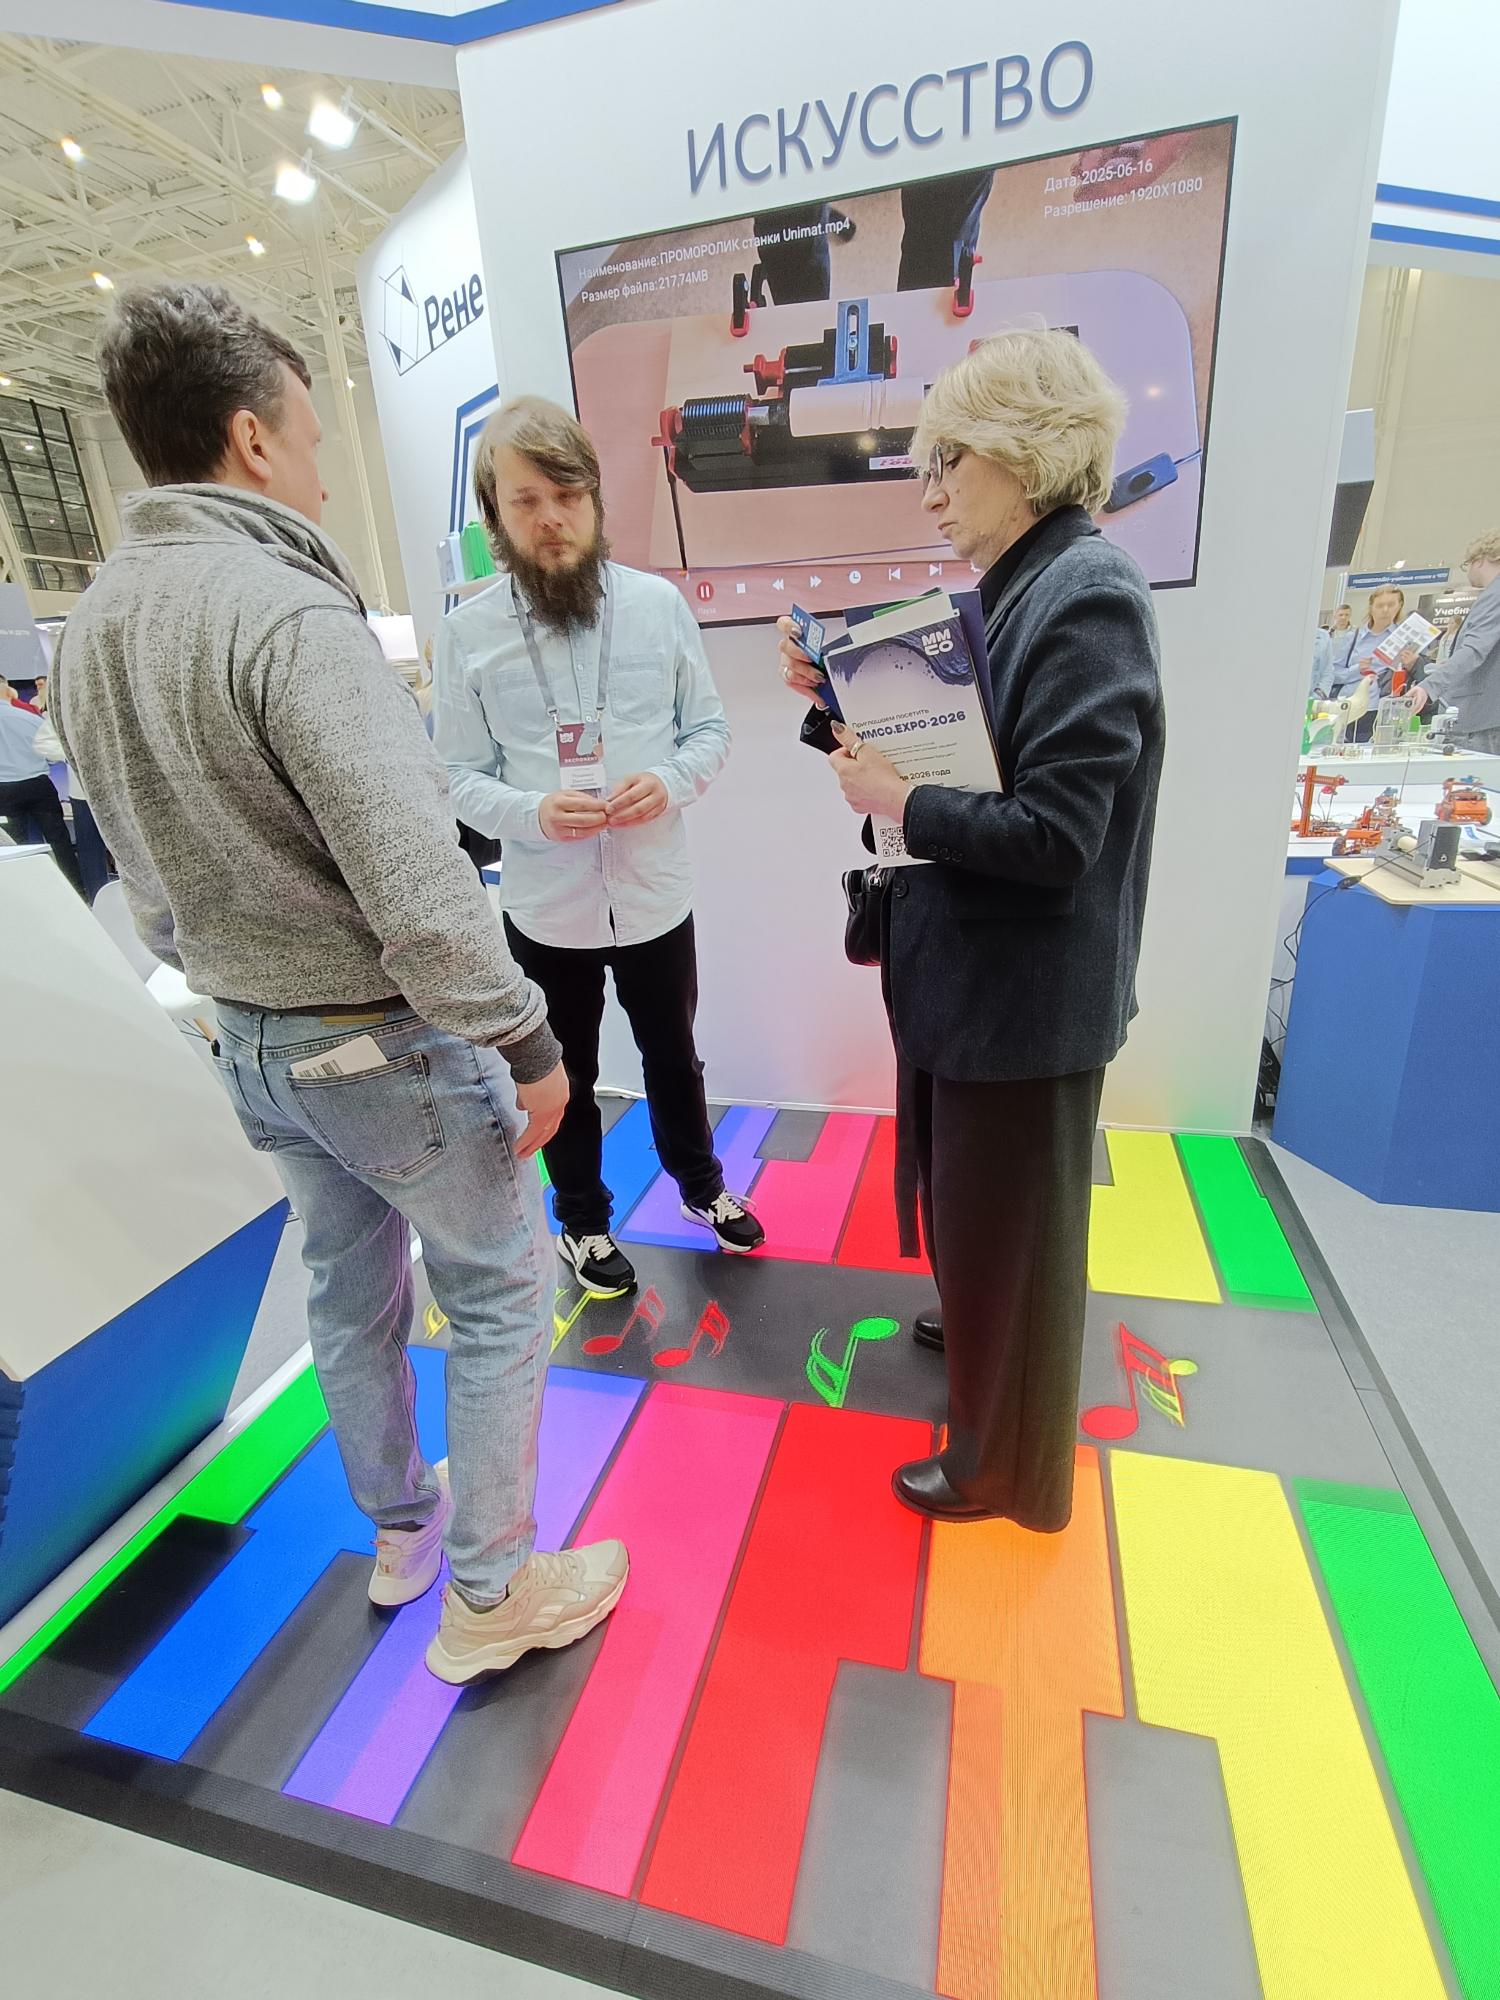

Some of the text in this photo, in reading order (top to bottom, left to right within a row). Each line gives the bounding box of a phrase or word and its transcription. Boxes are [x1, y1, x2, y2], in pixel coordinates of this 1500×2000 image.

[686, 40, 1095, 196] ИСКУССТВО
[742, 232, 781, 250] станки
[782, 216, 851, 242] Unimat.mp4
[581, 286, 620, 304] Размер
[851, 708, 930, 729] Приглашаем посетить
[908, 770, 931, 780] 2026
[931, 768, 951, 777] года
